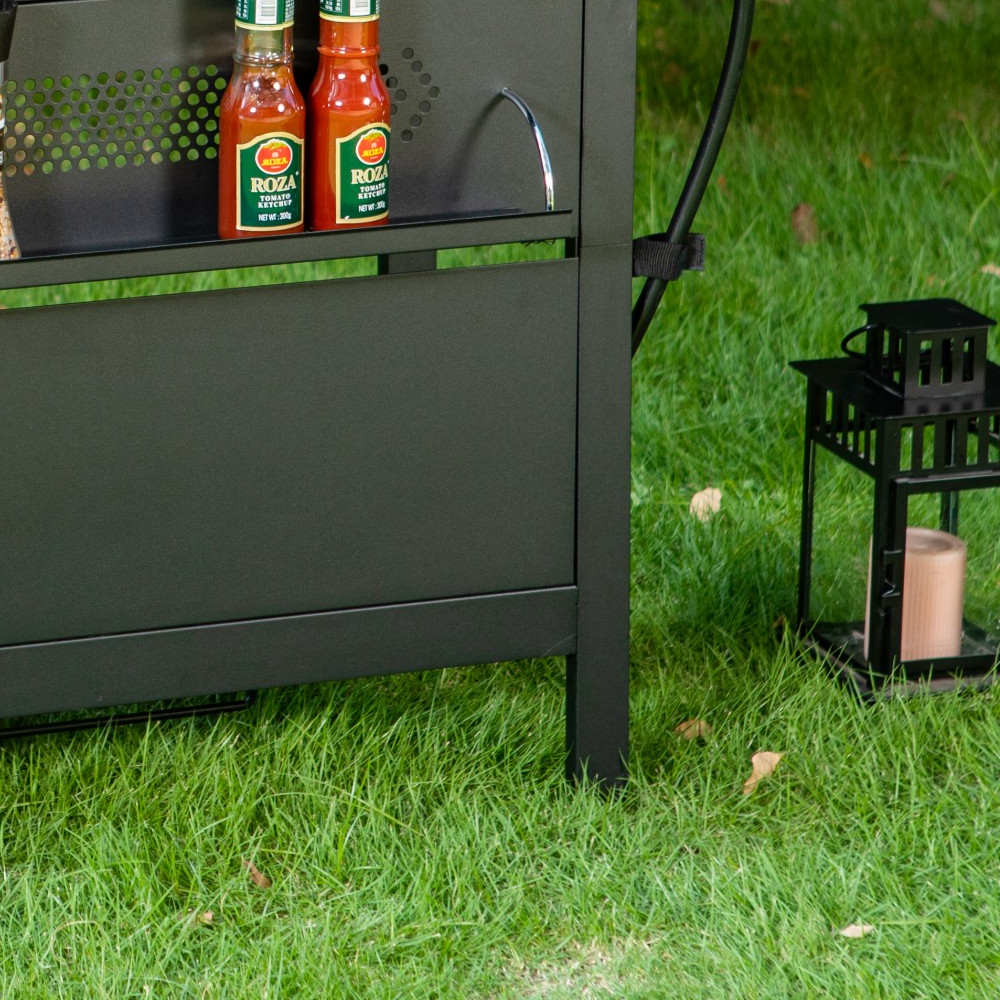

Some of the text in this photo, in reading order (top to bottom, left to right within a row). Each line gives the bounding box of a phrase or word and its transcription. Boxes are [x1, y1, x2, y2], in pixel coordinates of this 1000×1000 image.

[362, 147, 383, 157] ROZA
[261, 157, 288, 167] ROZA
[350, 163, 388, 184] ROZA
[250, 174, 297, 193] ROZA
[360, 182, 385, 193] TOMATO
[260, 193, 291, 202] TOMATO
[358, 188, 386, 199] KETCHUP
[258, 200, 292, 208] KETCHUP
[358, 204, 367, 213] NET
[258, 213, 268, 222] NET
[268, 213, 277, 221] WT
